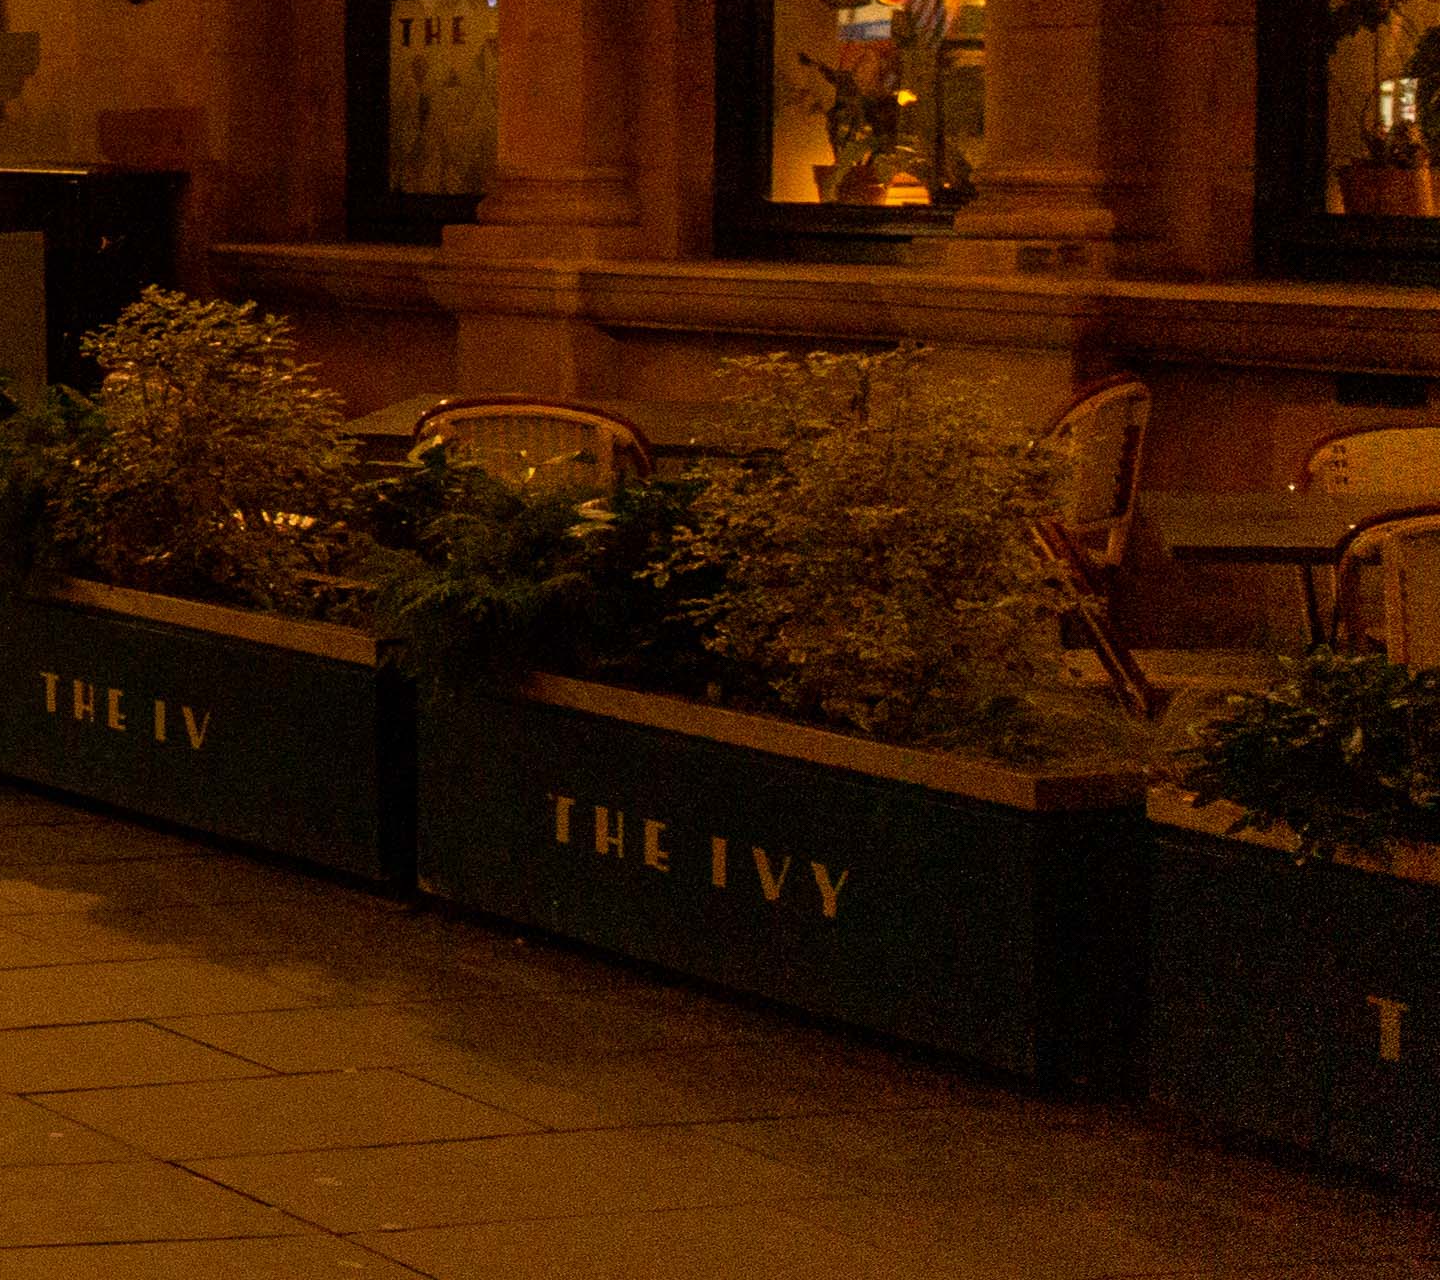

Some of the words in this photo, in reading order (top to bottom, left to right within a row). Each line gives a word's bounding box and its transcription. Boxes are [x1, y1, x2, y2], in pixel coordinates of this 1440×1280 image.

[398, 16, 466, 47] THE
[40, 670, 127, 732] THE
[546, 792, 671, 873] THE
[711, 836, 849, 918] IVY
